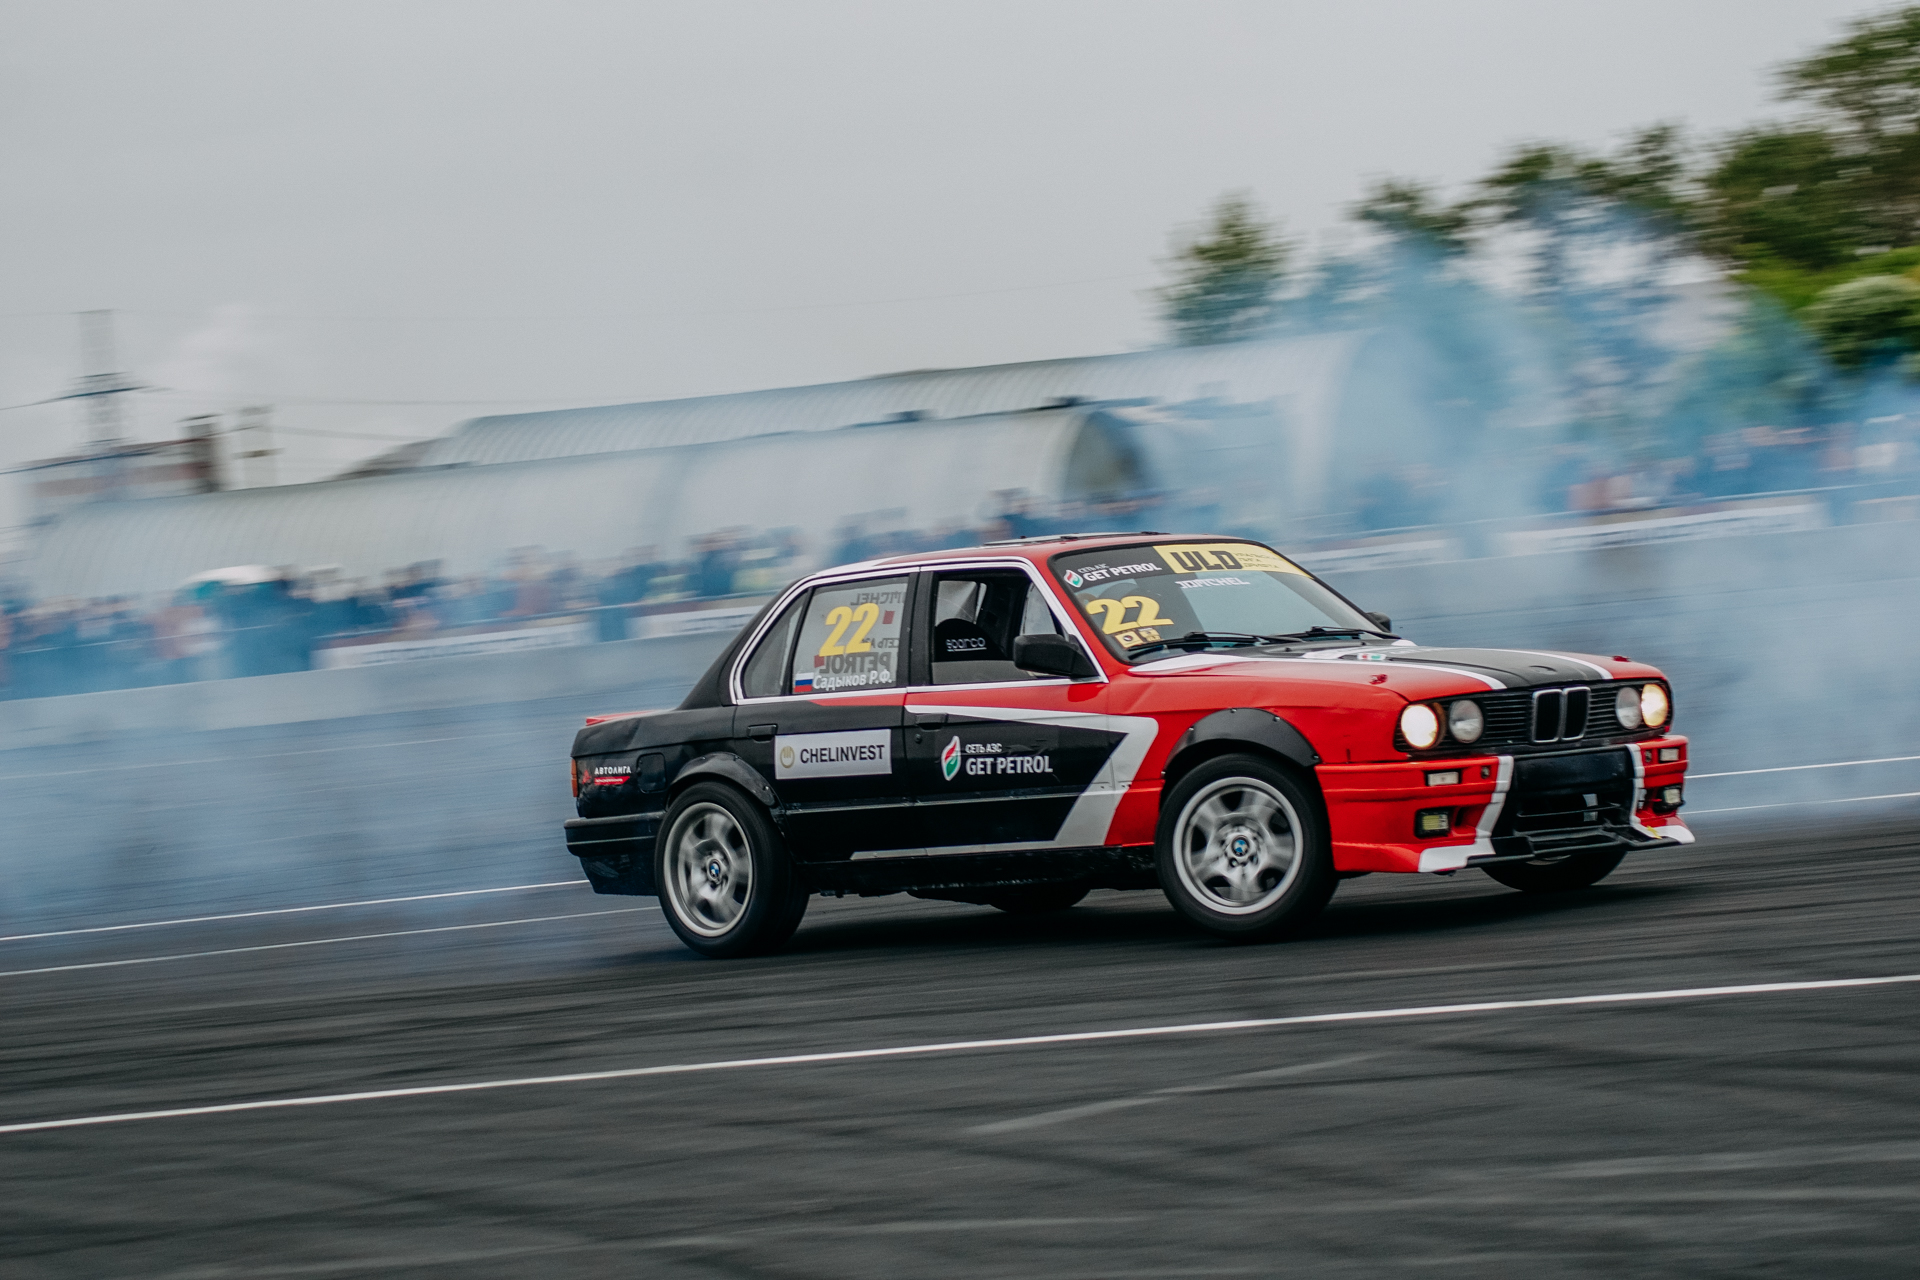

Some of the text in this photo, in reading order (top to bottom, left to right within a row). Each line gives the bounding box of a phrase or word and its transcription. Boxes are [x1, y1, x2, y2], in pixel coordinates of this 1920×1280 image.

[1169, 550, 1243, 572] ULD
[1082, 562, 1163, 582] GET PETROL
[1085, 595, 1174, 635] 22
[818, 602, 880, 657] 22
[945, 637, 986, 649] sparco
[813, 669, 893, 691] Садыков Р.Ф.
[800, 744, 885, 764] CHELINVEST
[964, 743, 1003, 754] СЕТЬ АЗС
[594, 765, 632, 775] АВТОЛИГА
[965, 755, 1053, 776] GET PETROL
